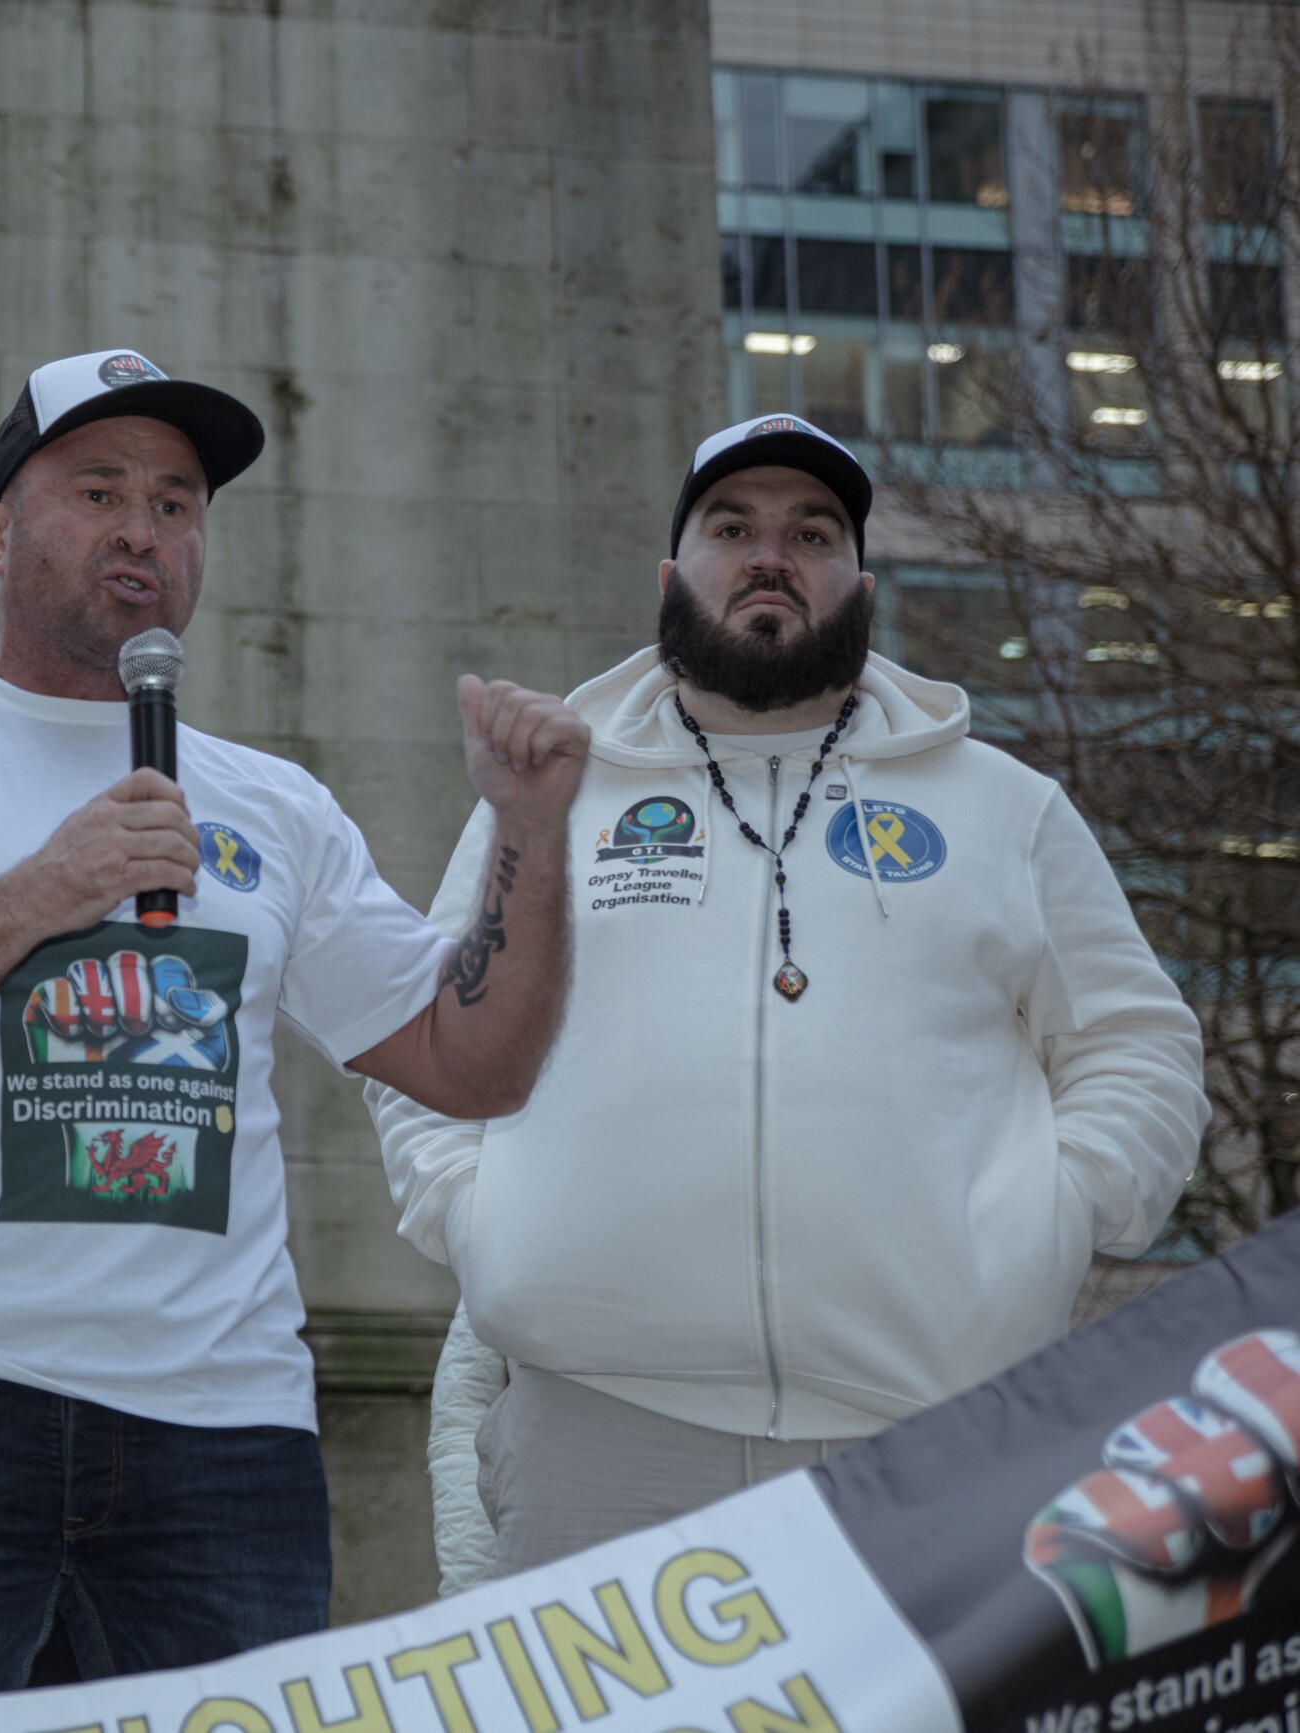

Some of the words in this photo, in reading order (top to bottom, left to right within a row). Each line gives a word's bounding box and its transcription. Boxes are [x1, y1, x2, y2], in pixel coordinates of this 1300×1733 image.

[863, 804, 906, 815] LETS
[632, 846, 663, 856] GTL
[842, 856, 882, 874] STA
[885, 860, 935, 878] TALKING
[588, 870, 634, 887] Gypsy
[613, 881, 672, 893] League
[591, 892, 690, 910] Organisation
[6, 1073, 38, 1092] We
[42, 1070, 103, 1089] stand
[108, 1073, 133, 1089] as
[137, 1073, 175, 1091] one
[179, 1079, 234, 1102] against
[12, 1095, 212, 1127] Discrimination
[22, 1547, 790, 1733] HTING
[1109, 1640, 1245, 1731] stand
[1254, 1633, 1300, 1683] as
